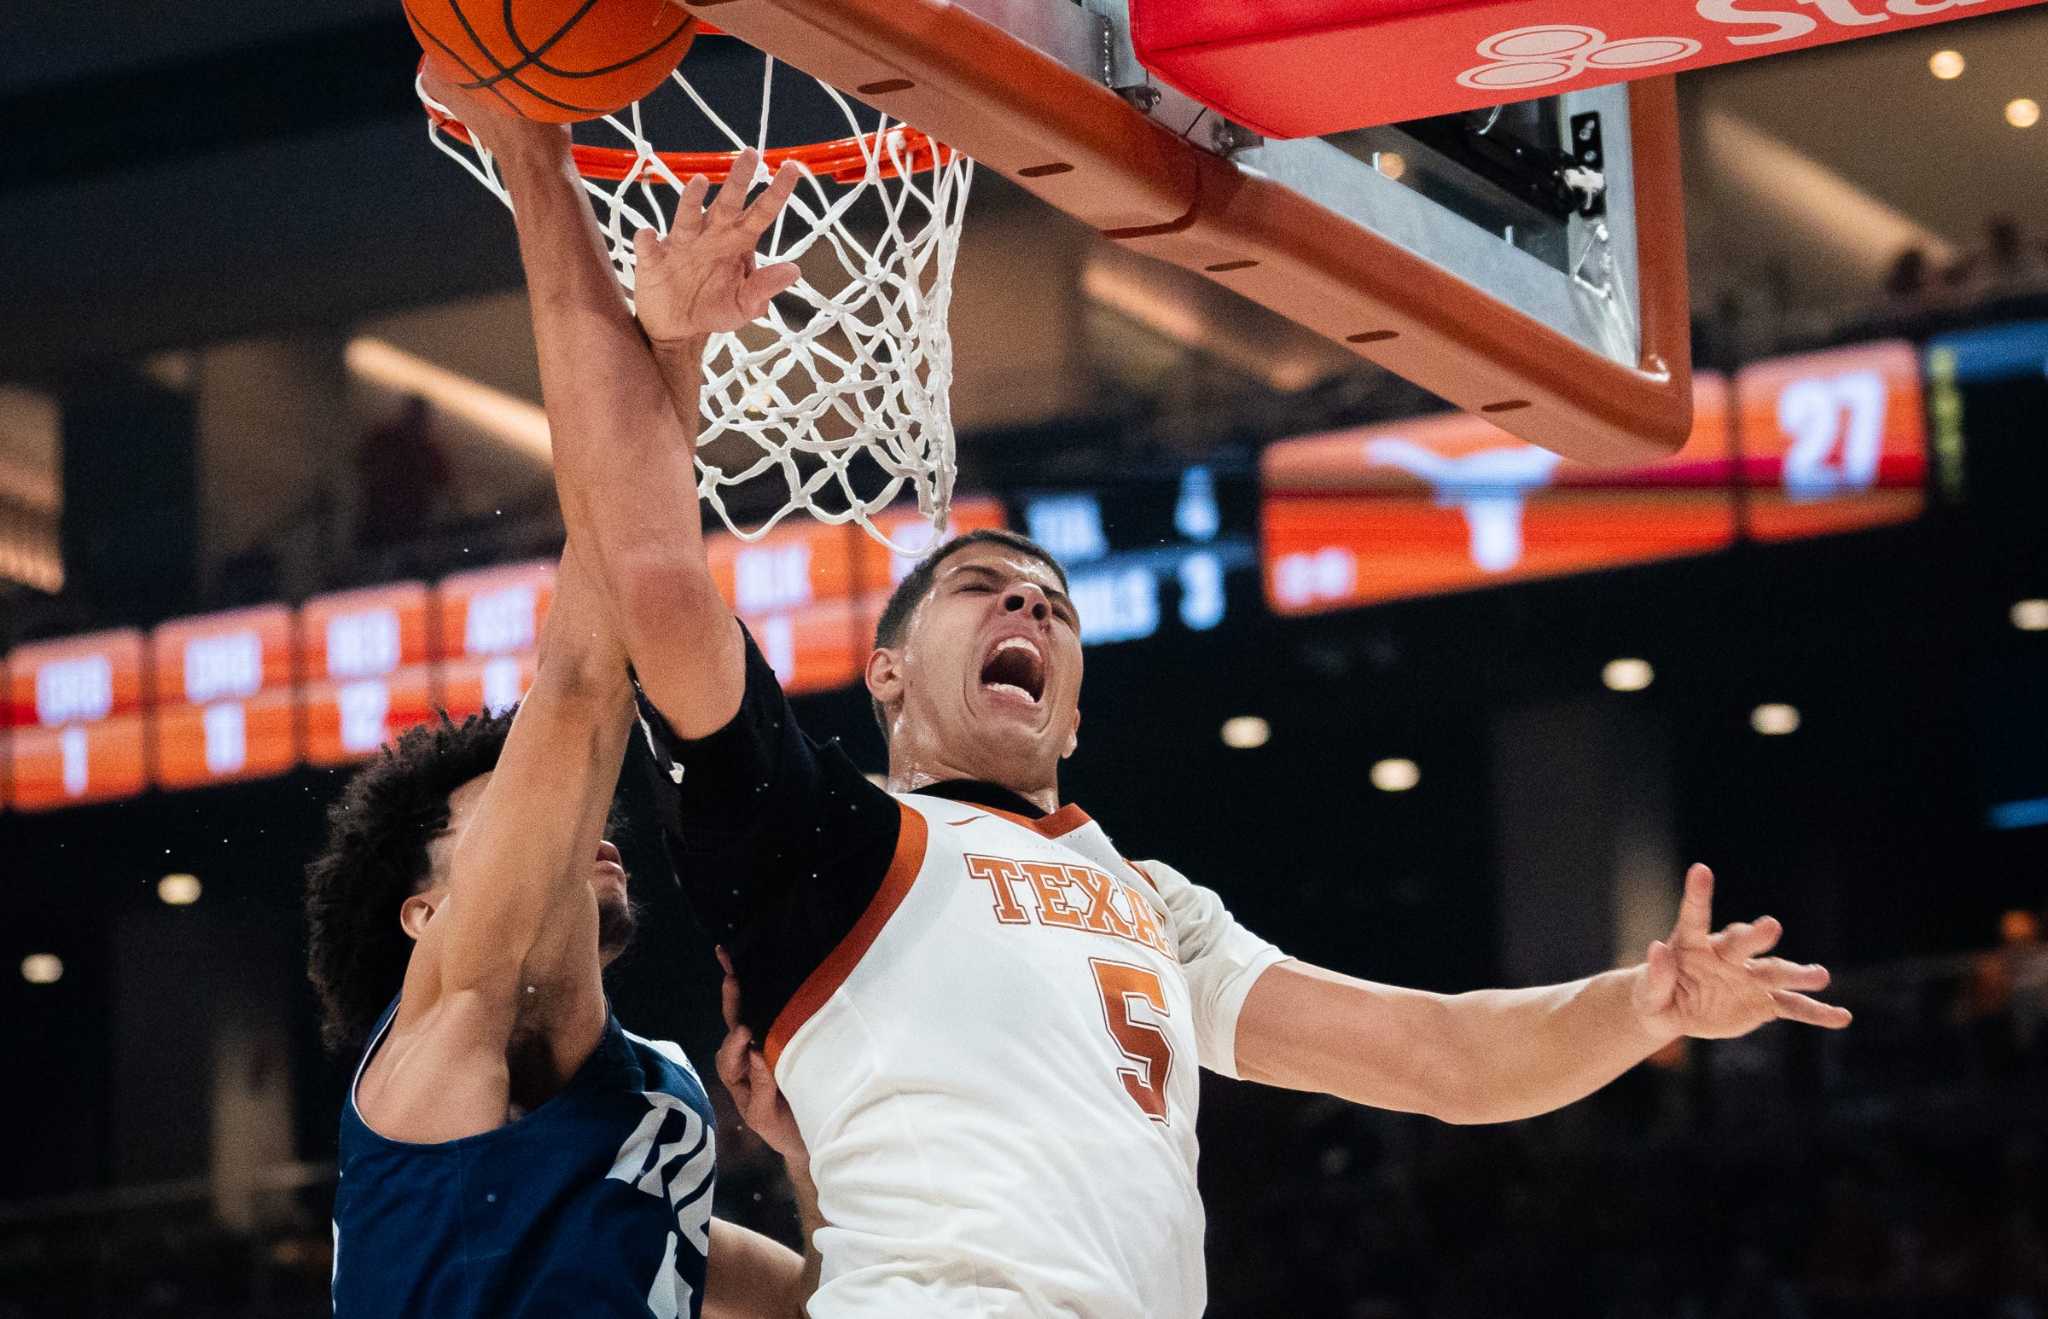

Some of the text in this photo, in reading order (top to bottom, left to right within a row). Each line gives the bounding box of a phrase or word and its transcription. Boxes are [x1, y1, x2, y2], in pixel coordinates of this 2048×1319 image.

[1780, 371, 1886, 499] 27
[1178, 551, 1227, 632] 3
[963, 853, 1179, 962] TEXA
[1089, 957, 1174, 1126] 5
